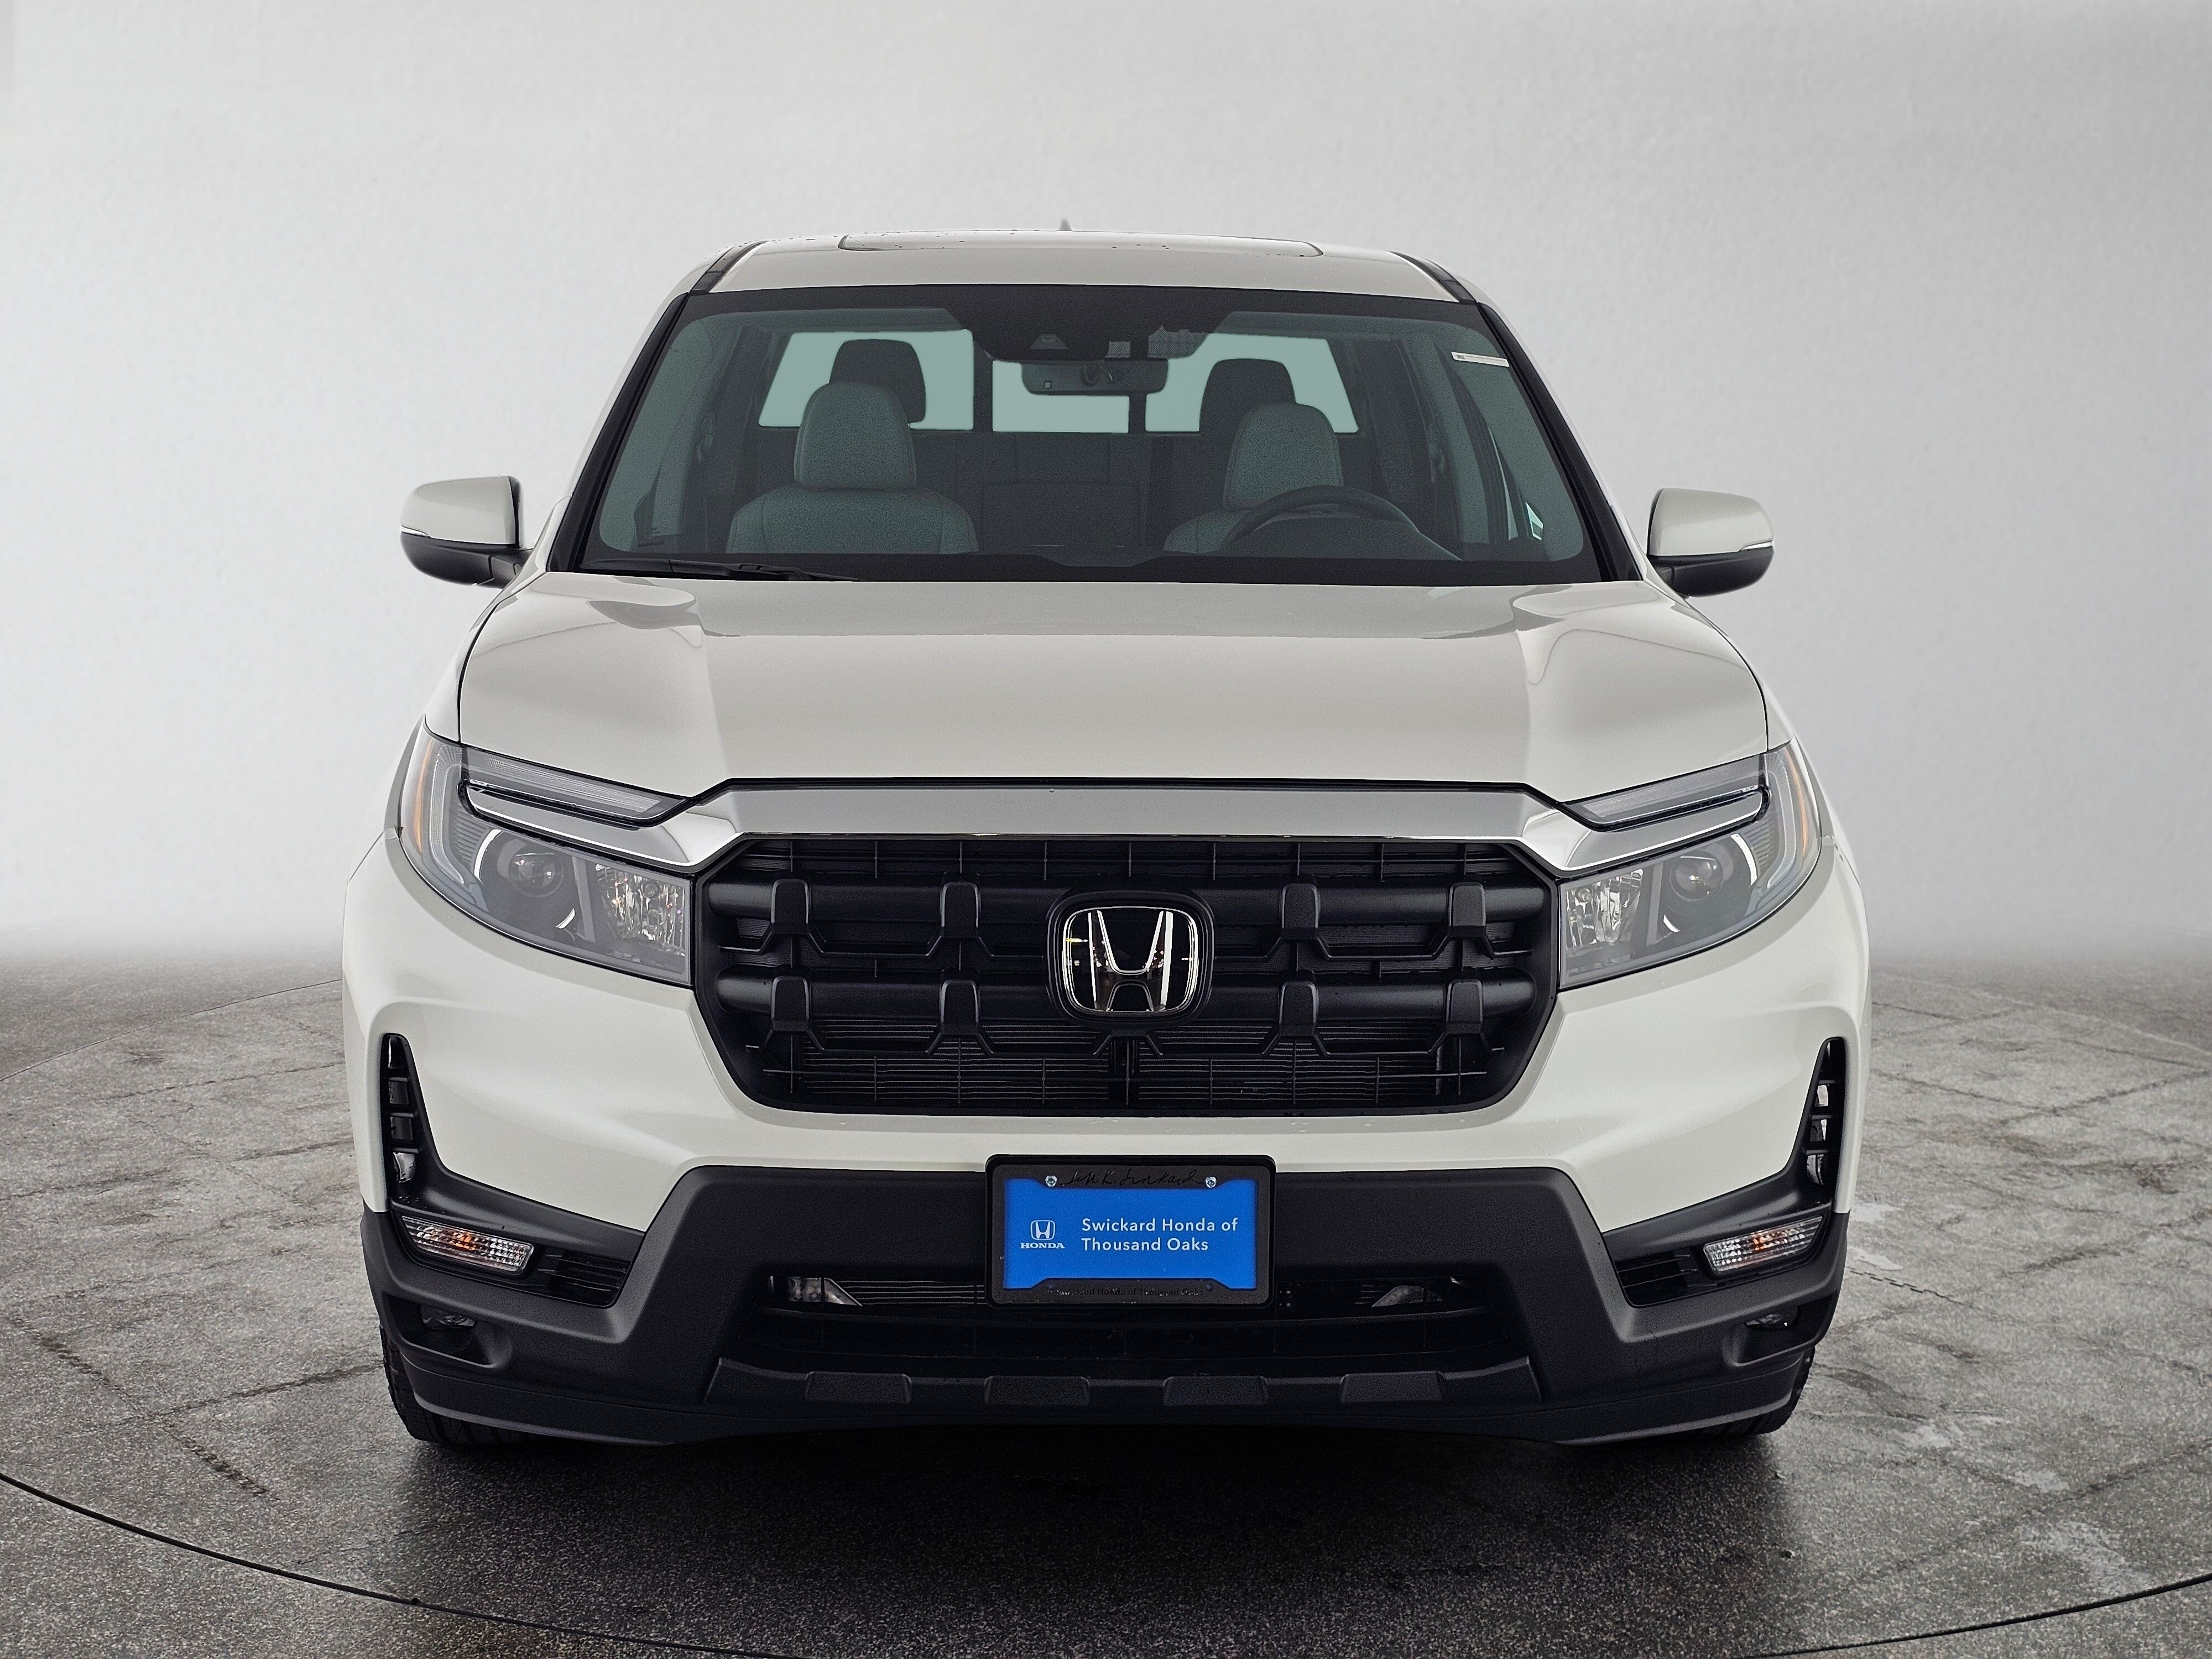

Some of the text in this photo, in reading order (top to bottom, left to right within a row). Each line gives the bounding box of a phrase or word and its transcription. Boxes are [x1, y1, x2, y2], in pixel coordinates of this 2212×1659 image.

[1082, 1217, 1238, 1232] Swickard Honda of
[1081, 1237, 1208, 1251] Thousand Oaks
